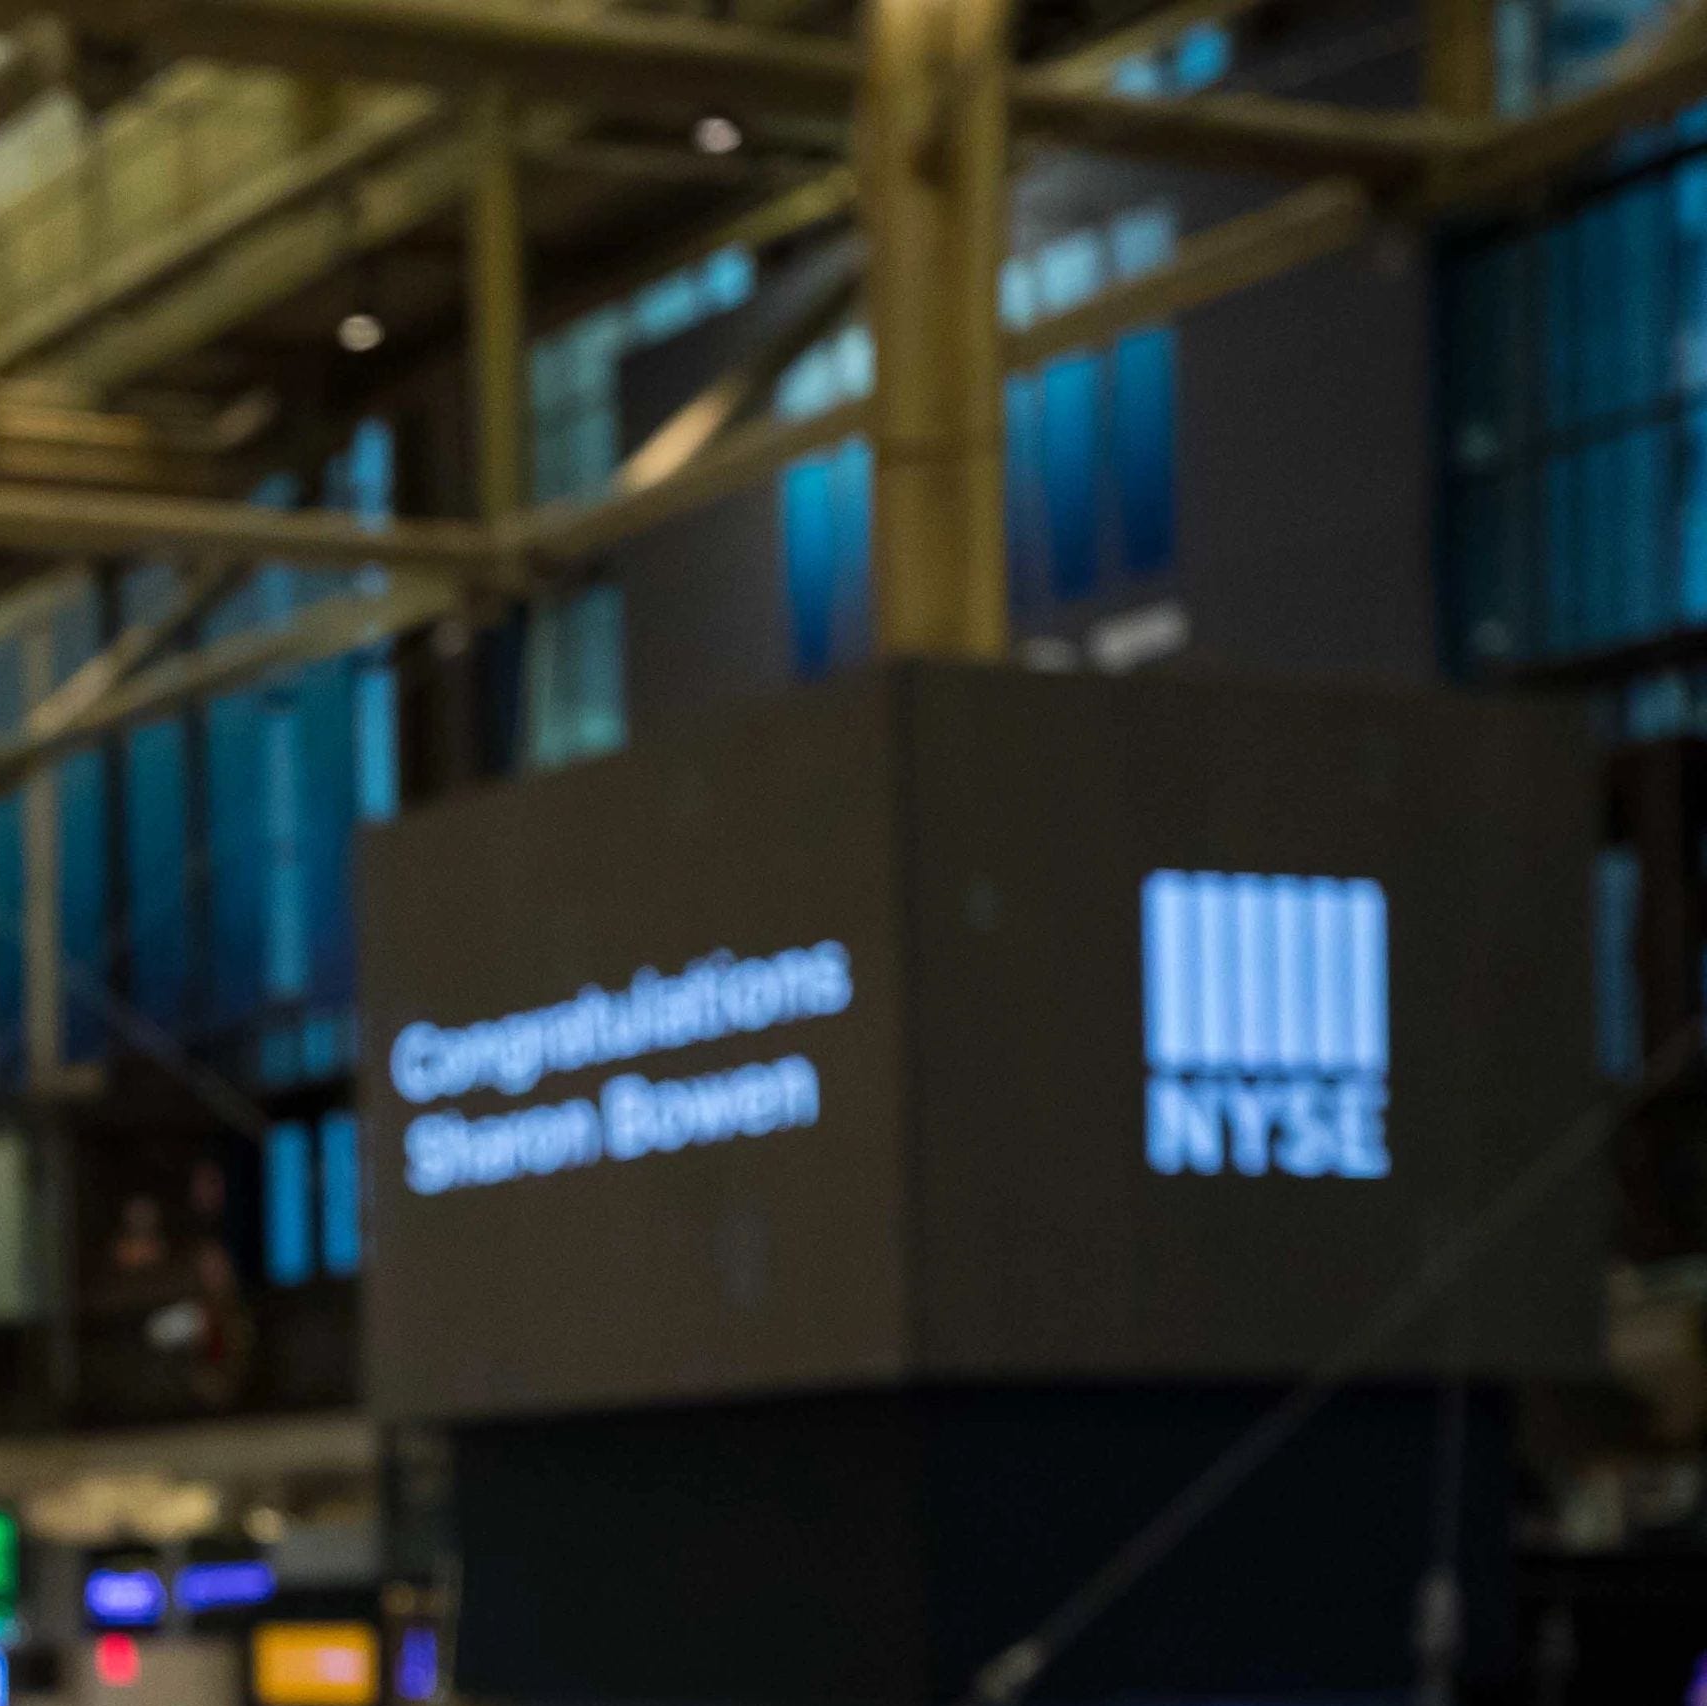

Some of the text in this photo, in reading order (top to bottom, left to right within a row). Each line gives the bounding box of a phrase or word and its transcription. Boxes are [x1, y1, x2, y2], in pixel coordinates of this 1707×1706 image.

[390, 940, 854, 1104] Congratulations
[404, 1054, 821, 1195] Sharon Bowen
[1145, 1078, 1393, 1180] NYSE
